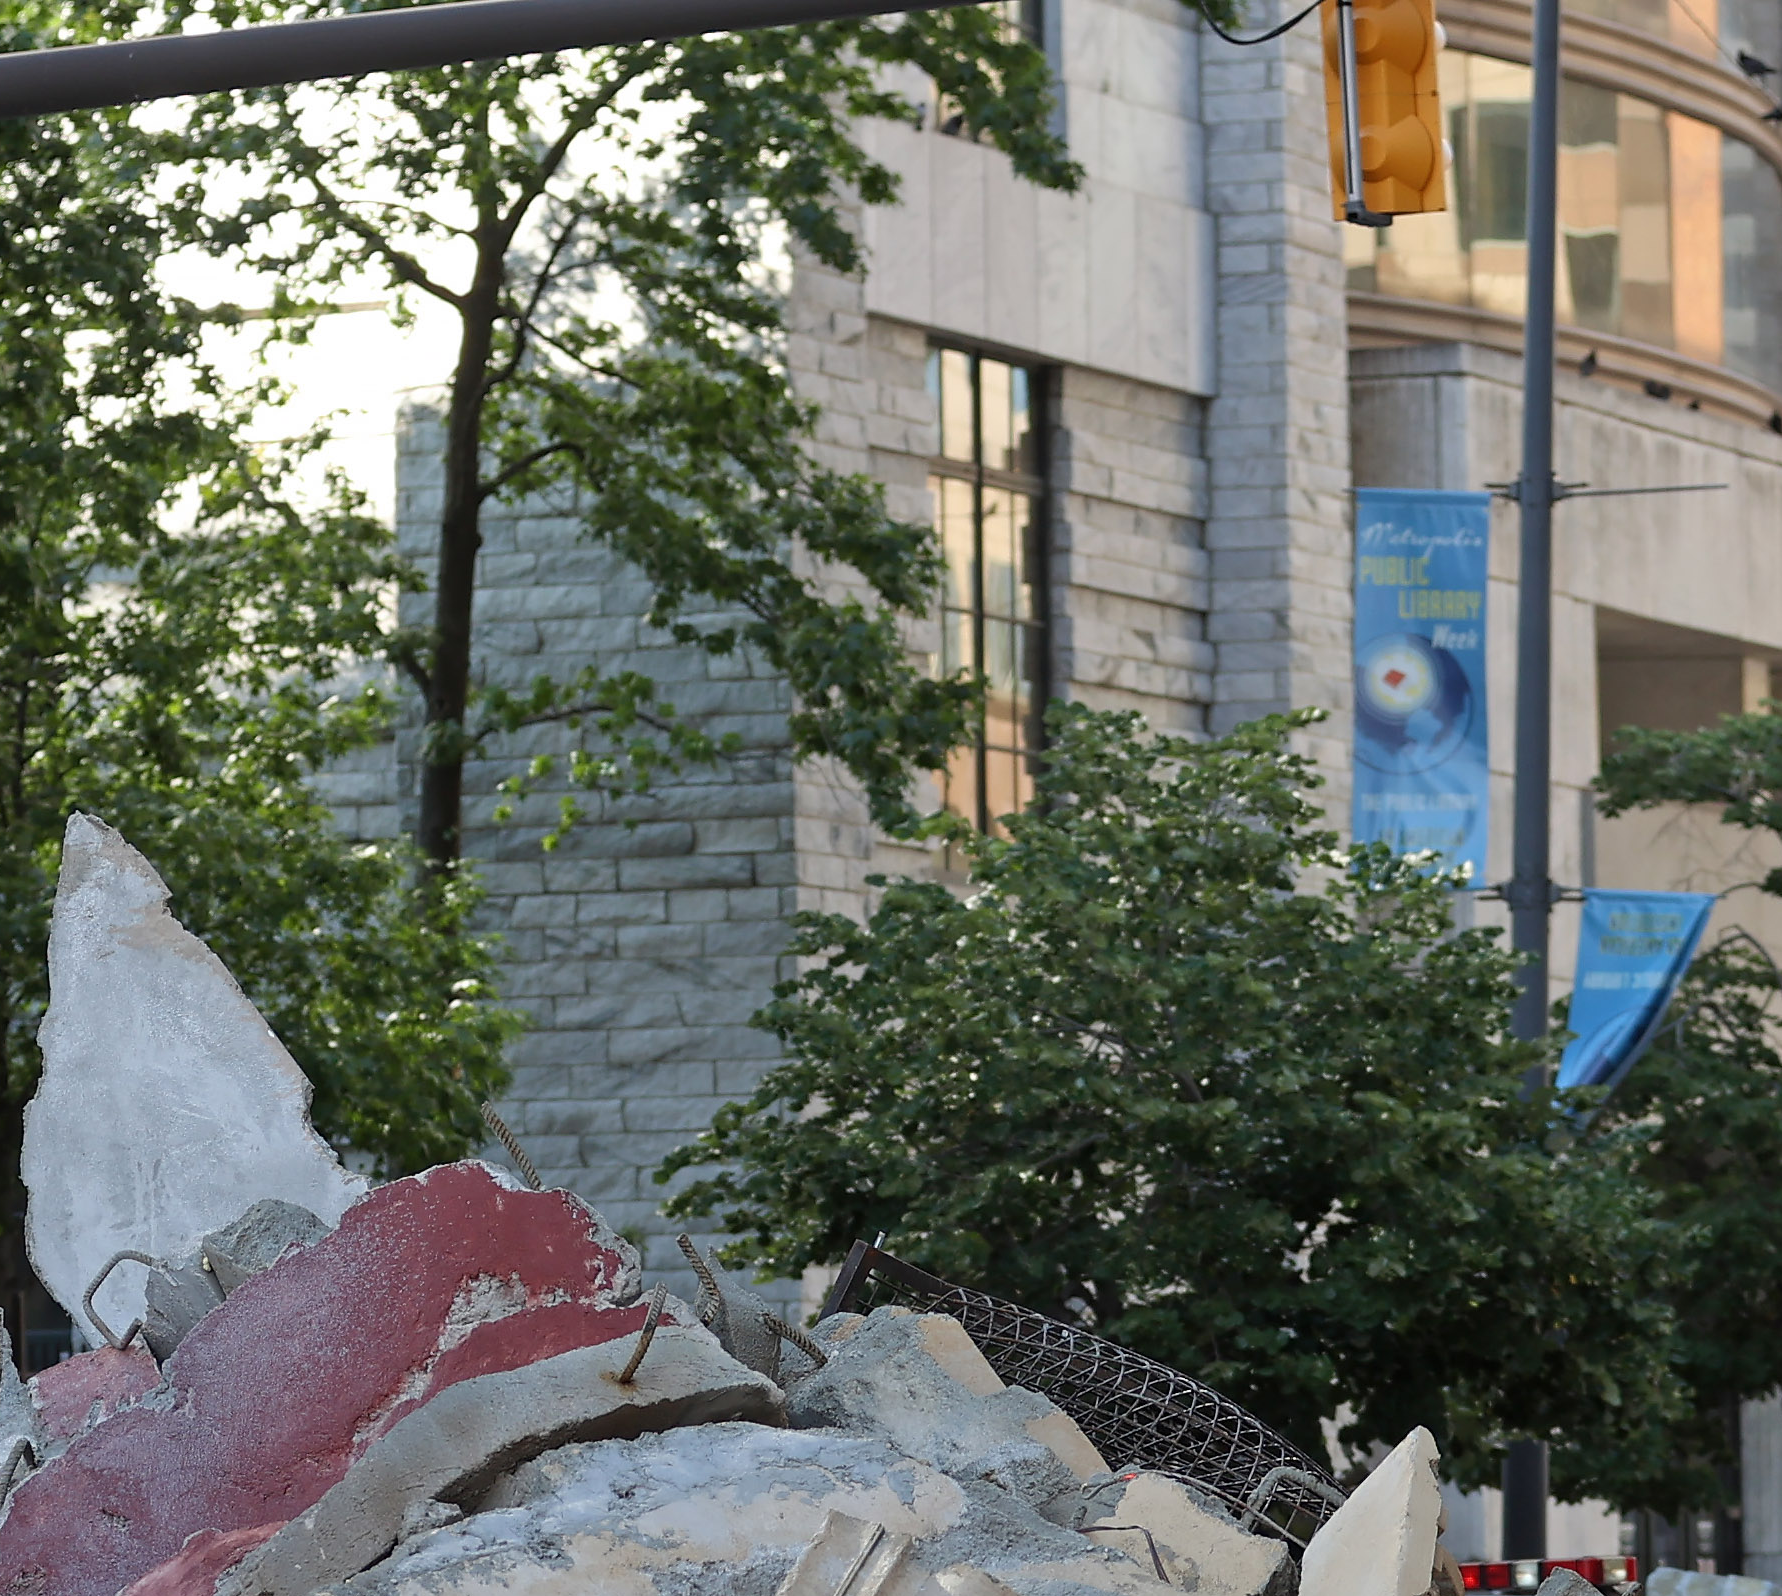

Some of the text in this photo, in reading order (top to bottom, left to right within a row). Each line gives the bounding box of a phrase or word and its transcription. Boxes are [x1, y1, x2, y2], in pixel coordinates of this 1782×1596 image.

[1360, 521, 1483, 558] Metropolis
[1360, 556, 1430, 586] PUBLIC
[1399, 589, 1482, 619] LIBRARY
[1431, 623, 1477, 650] Week
